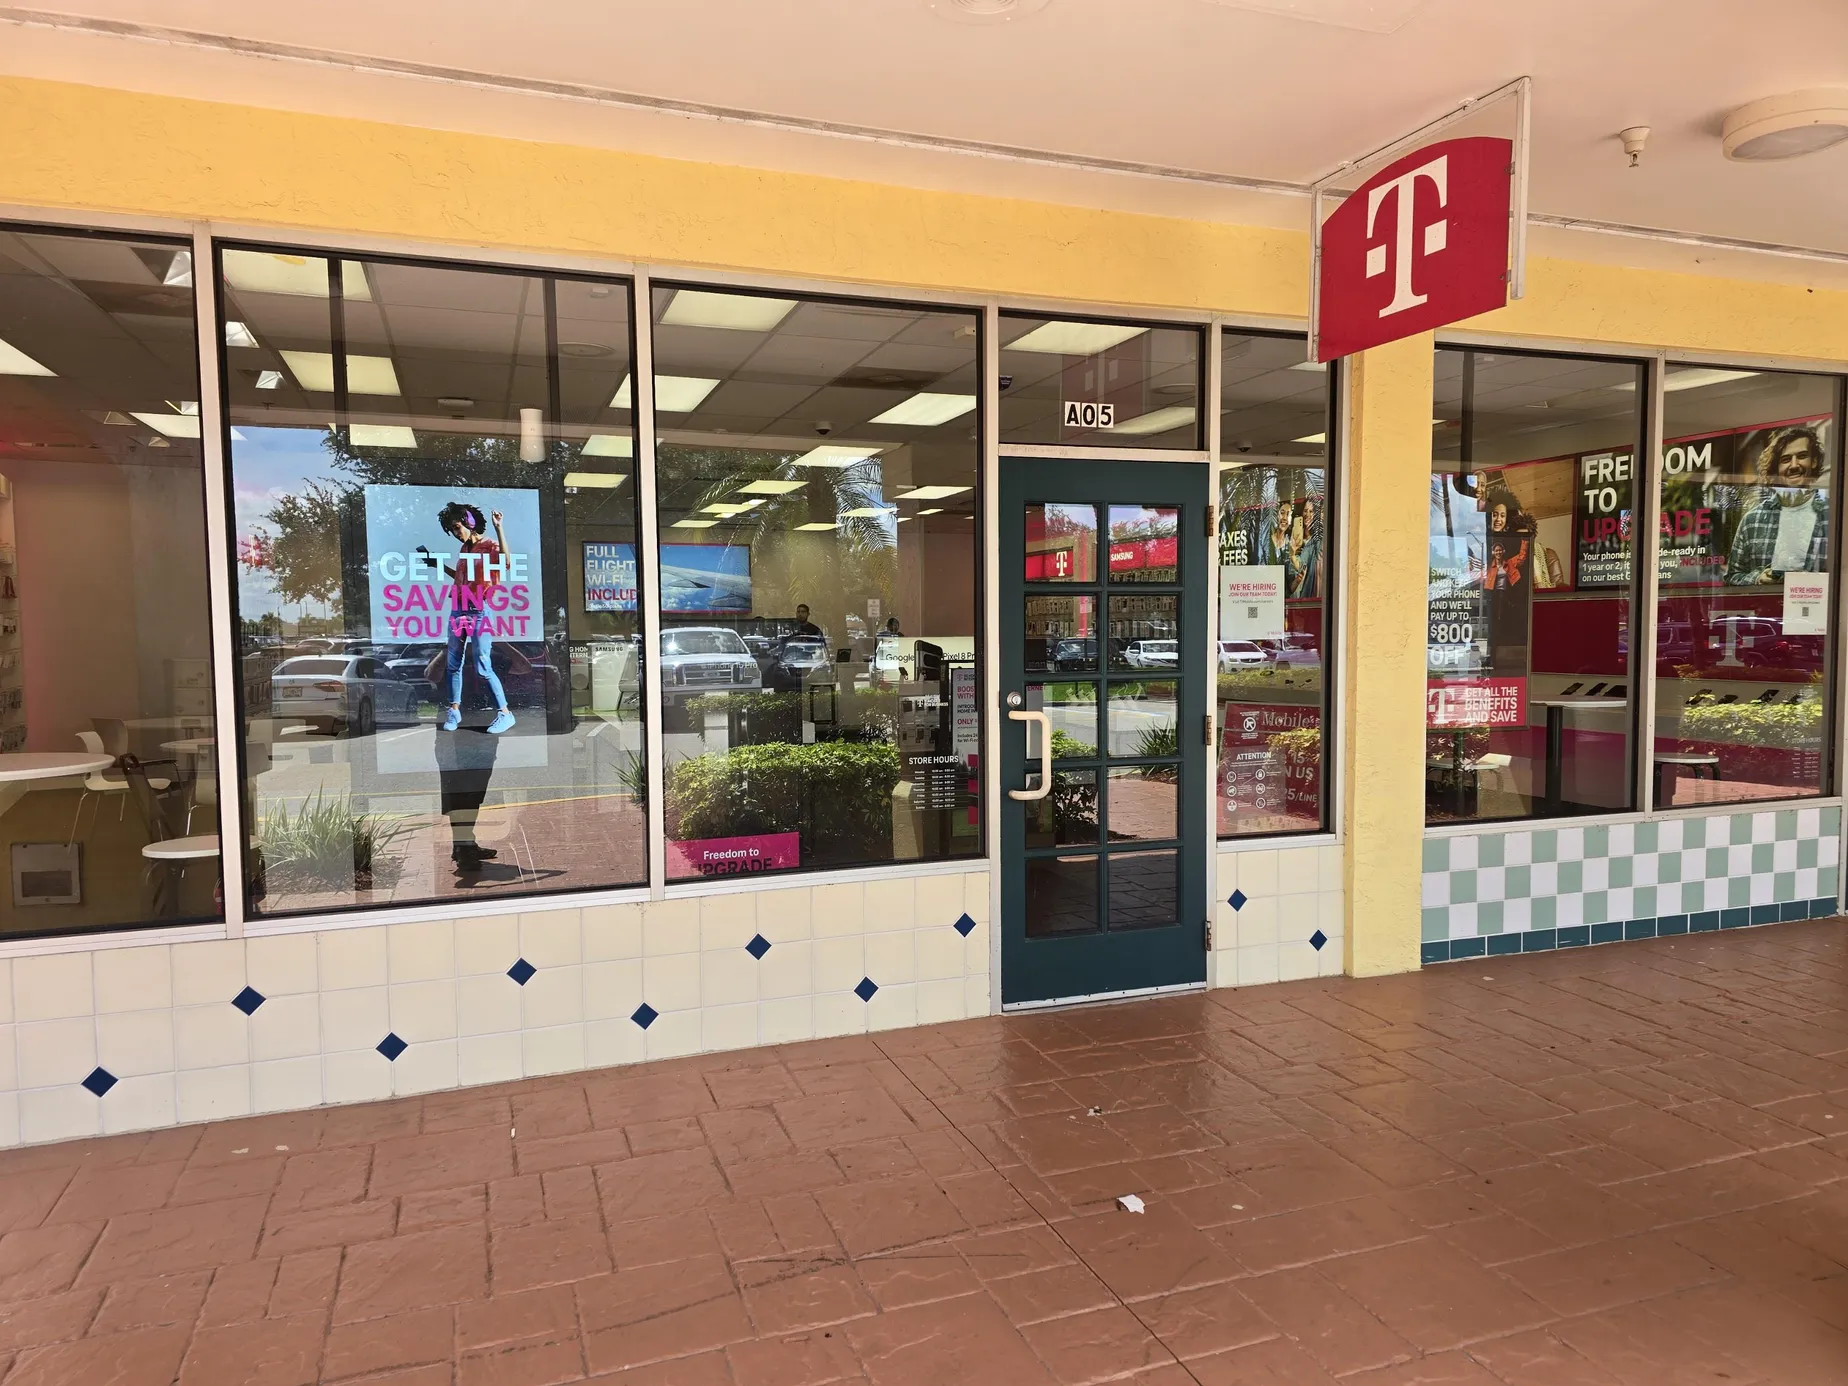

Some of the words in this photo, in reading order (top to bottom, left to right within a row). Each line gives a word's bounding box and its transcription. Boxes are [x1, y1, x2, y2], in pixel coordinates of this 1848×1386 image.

[1366, 154, 1447, 318] T
[1066, 403, 1112, 426] A05
[1584, 443, 1712, 485] FREOM
[1584, 487, 1617, 514] TO
[1583, 508, 1712, 543] UPGADE
[1219, 530, 1247, 547] AXES
[586, 545, 619, 558] FULL
[1110, 551, 1134, 562] SAMSUNG
[1223, 549, 1248, 566] FEES
[1583, 552, 1600, 561] Your
[1601, 551, 1625, 562] phone
[1697, 545, 1706, 554] in
[379, 551, 451, 582] GET
[458, 552, 529, 582] THE
[586, 560, 635, 572] FLIGHT
[1056, 551, 1067, 576] T
[1588, 563, 1606, 573] year
[1660, 559, 1678, 569] you,
[1680, 556, 1726, 567] INCLUDED
[1431, 567, 1462, 577] SWITCH
[1582, 574, 1592, 582] on
[1592, 574, 1606, 582] our
[1606, 572, 1625, 581] best
[587, 574, 623, 586] WI-FI
[1229, 583, 1251, 591] WE'RE
[1252, 583, 1277, 591] HIRING
[383, 584, 530, 612] SAVINGS
[1453, 589, 1480, 599] PHONE
[1430, 600, 1448, 610] AND
[1449, 600, 1472, 610] WE'LL
[1430, 611, 1446, 621] PAY
[1446, 611, 1458, 621] UP
[1458, 611, 1469, 621] TO
[385, 616, 442, 638] YOU
[450, 616, 531, 637] WANT
[1430, 623, 1473, 644] $800
[1708, 610, 1755, 667] T
[885, 653, 915, 664] Google
[943, 652, 961, 661] Pixel
[961, 652, 966, 660] 8
[1430, 645, 1465, 666] OFF
[745, 661, 758, 669] Pro
[1484, 687, 1500, 697] ALL
[1501, 686, 1518, 696] THE
[1465, 697, 1518, 710] BENEFITS
[1465, 711, 1488, 723] AND
[1490, 710, 1517, 723] SAVE
[908, 756, 933, 765] STORE
[933, 755, 959, 764] HOURS
[1236, 752, 1272, 760] ATTENTION
[703, 848, 747, 860] Freedom
[748, 847, 760, 857] to
